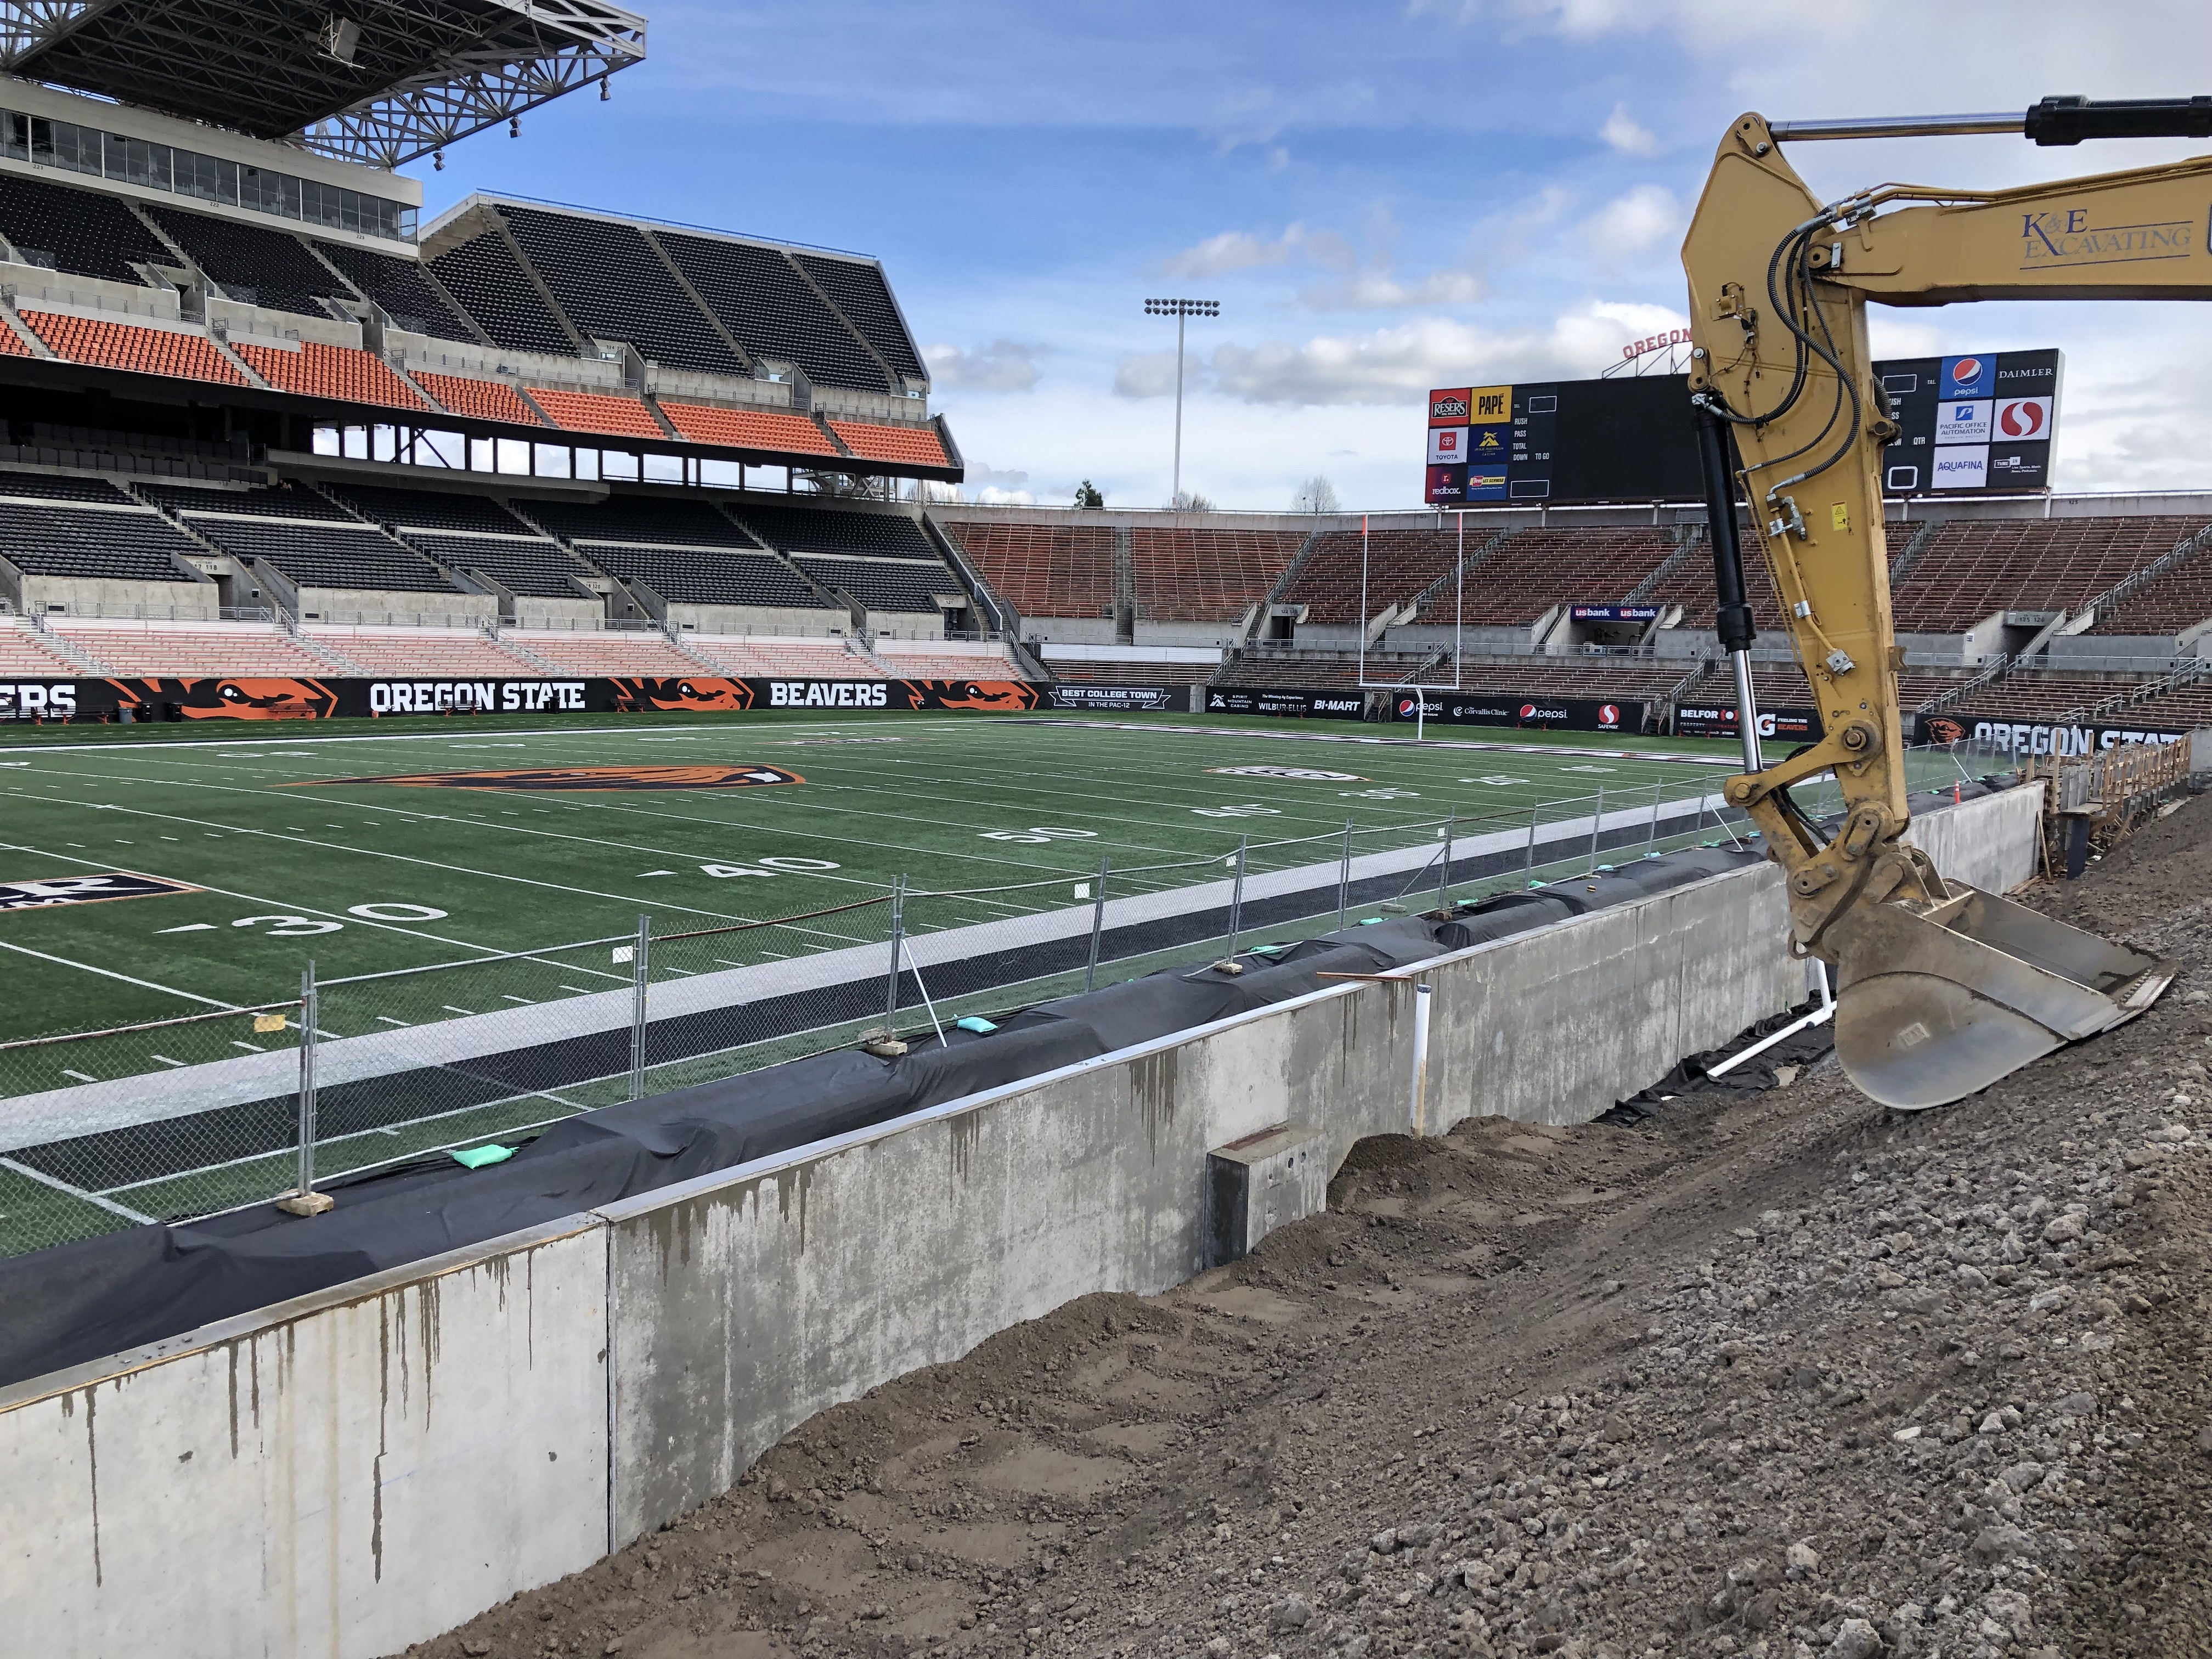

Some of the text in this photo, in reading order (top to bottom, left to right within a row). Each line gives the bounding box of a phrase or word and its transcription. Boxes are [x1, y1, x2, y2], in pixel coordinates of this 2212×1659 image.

[2024, 228, 2191, 259] EXCAVATING
[1623, 328, 1692, 359] OREGON
[1999, 368, 2053, 379] DAIMLER
[1954, 387, 1978, 396] pepsi
[1434, 401, 1465, 416] RESER'S
[1913, 437, 1926, 445] QTR
[1937, 461, 1983, 472] AQUAFINA
[370, 682, 585, 712] OREGON STATE
[770, 682, 887, 707] BEAVERS
[1062, 689, 1086, 697] BEST
[1087, 690, 1127, 698] COLLEGE
[1259, 703, 1307, 713] WILBUR-ELLIS
[1314, 700, 1361, 711] BI-MART
[1538, 709, 1567, 720] pepsi
[1680, 709, 1718, 719] BELFOR
[1975, 722, 2094, 755] OREGON
[977, 826, 1099, 843] 50
[698, 856, 841, 878] 40
[231, 902, 449, 935] 30
